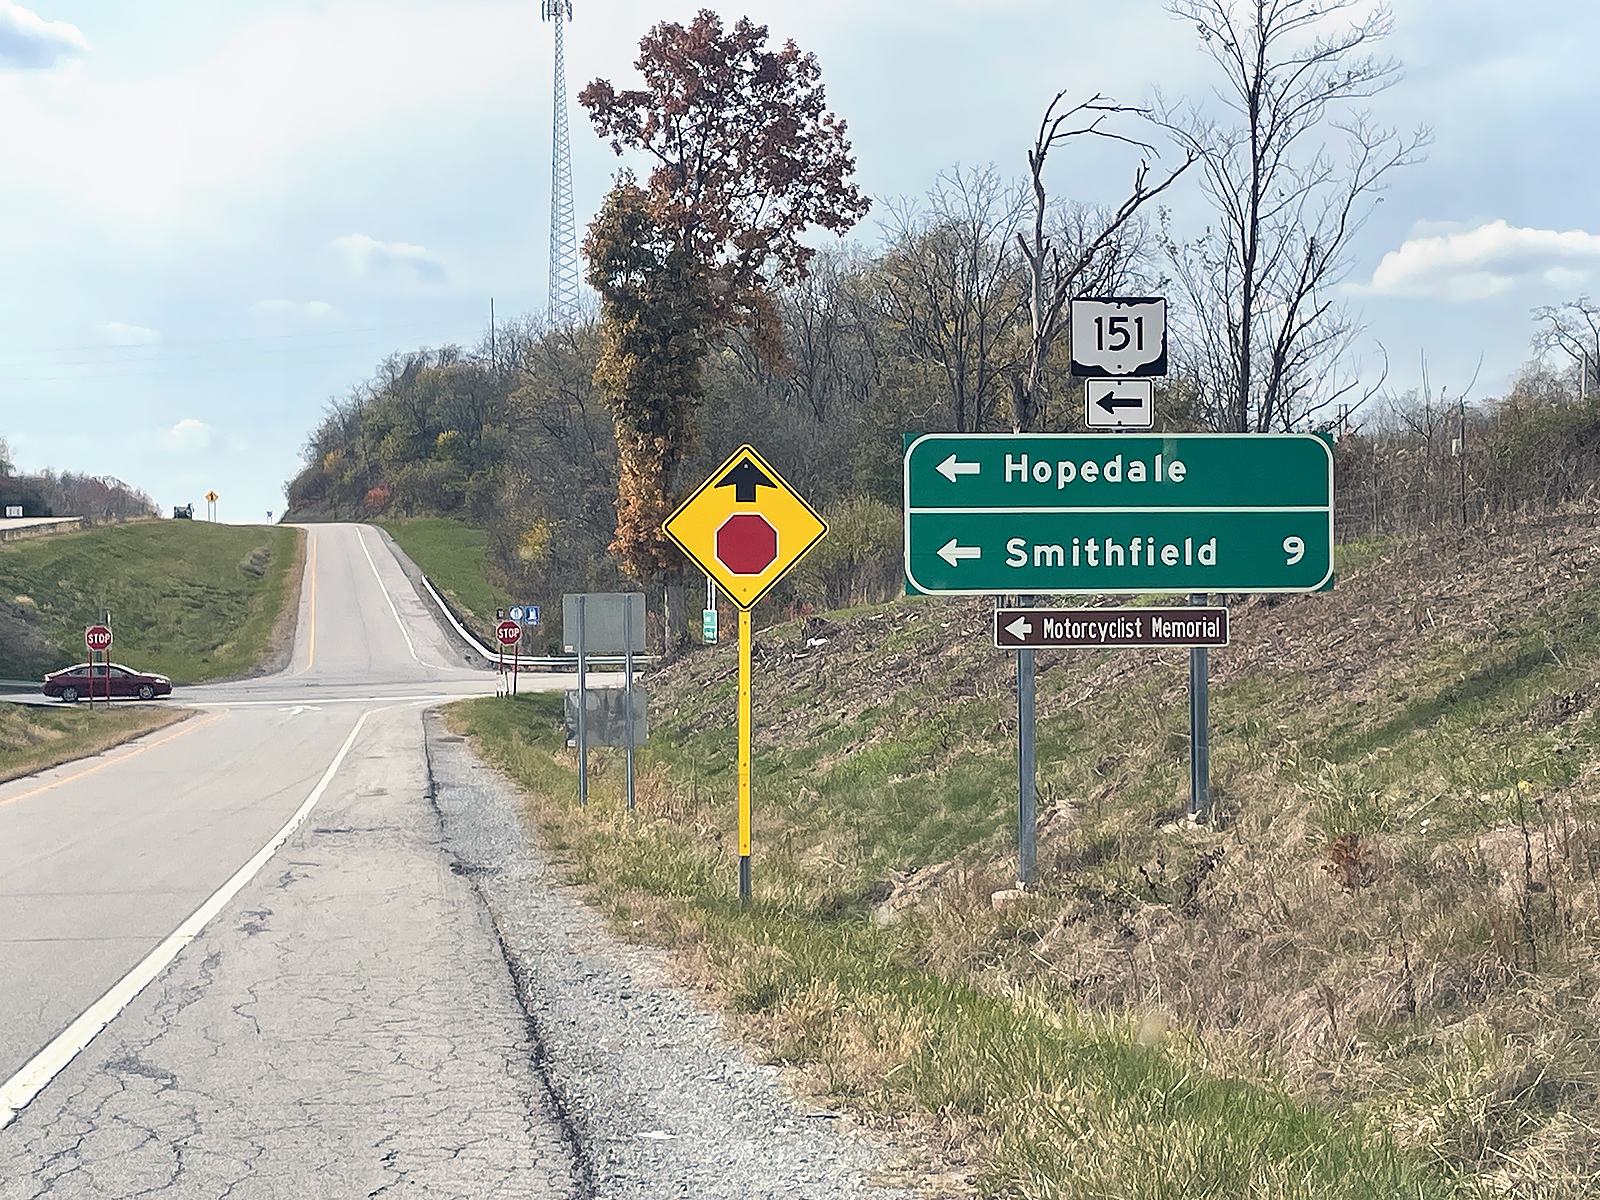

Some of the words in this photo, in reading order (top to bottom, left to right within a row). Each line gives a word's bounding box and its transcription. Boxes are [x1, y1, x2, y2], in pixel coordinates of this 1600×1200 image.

[1094, 316, 1144, 351] 151
[1005, 453, 1187, 489] Hopedale
[1005, 537, 1217, 567] Smithfield
[1282, 536, 1306, 567] 9
[88, 633, 110, 644] STOP
[498, 627, 520, 639] STOP
[1043, 617, 1143, 643] Motorcyclist
[1151, 616, 1220, 638] Memorial
